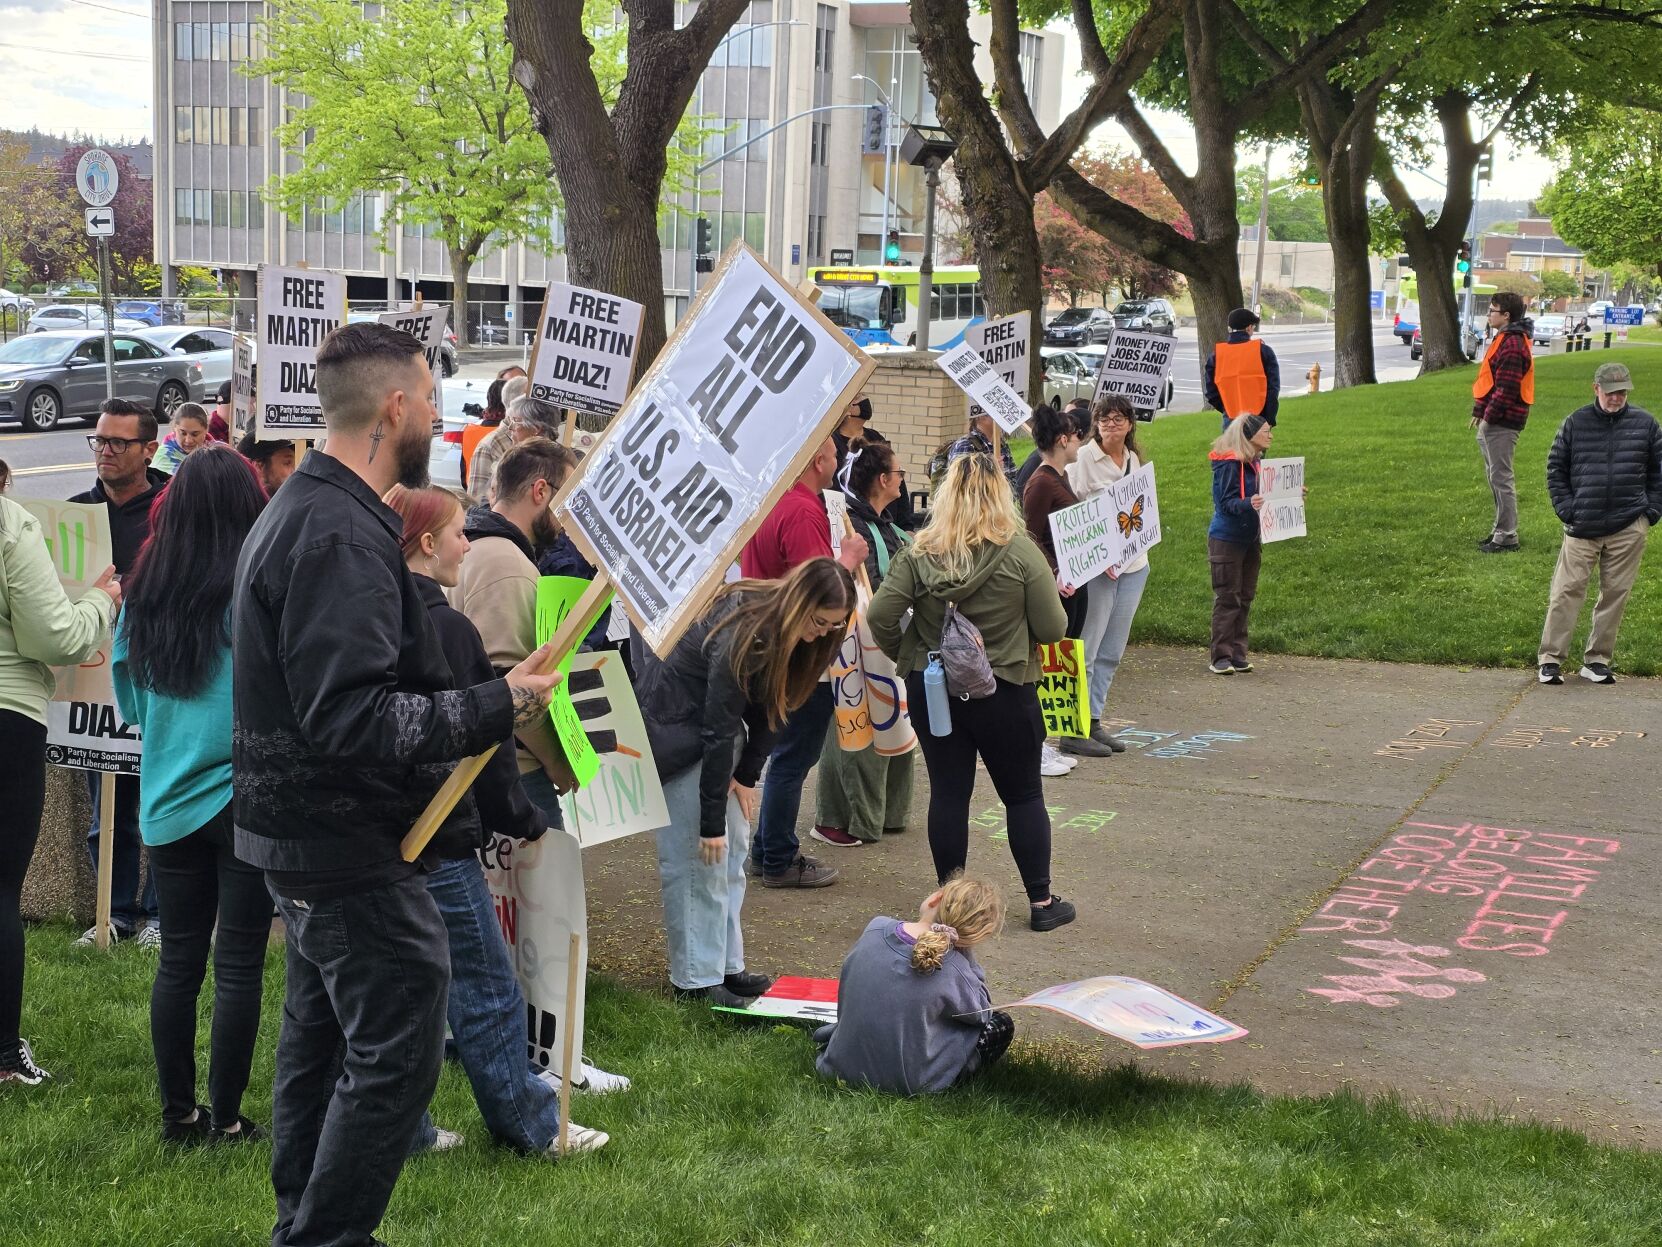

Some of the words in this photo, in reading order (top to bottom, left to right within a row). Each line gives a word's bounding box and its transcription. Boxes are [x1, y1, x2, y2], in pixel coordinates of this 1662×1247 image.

[282, 276, 325, 310] FREE
[568, 291, 621, 325] FREE
[545, 316, 634, 358] MARTIN
[723, 284, 817, 395] END
[983, 320, 1015, 346] FREE
[1114, 336, 1150, 350] MONEY
[1150, 341, 1171, 353] FOR
[552, 355, 611, 391] DIAZ!
[947, 353, 972, 374] DONATE
[967, 350, 977, 362] TO
[1107, 359, 1162, 378] EDUCATION,
[1110, 348, 1141, 361] JOBS
[1141, 350, 1168, 365] AND
[957, 365, 981, 389] MARTIN
[975, 361, 991, 378] DIAZ
[1101, 380, 1124, 393] NOT
[1125, 382, 1157, 397] MASS
[687, 353, 764, 456] ALL
[592, 450, 626, 502] TO
[621, 402, 681, 493] U.S.
[660, 460, 733, 545] AID
[582, 507, 597, 529] Party
[594, 523, 602, 537] for
[1055, 498, 1101, 534] PROTECT
[608, 478, 697, 592] ISRAEL!
[1058, 517, 1109, 557] IMMIGRANT
[1139, 525, 1158, 549] RIGHT
[1067, 543, 1109, 579] RIGHTS
[68, 701, 142, 741] DIAZ
[67, 747, 87, 758] Party
[88, 750, 100, 759] for
[100, 752, 139, 763] Socialism
[67, 757, 81, 766] and
[82, 758, 120, 771] Liberation
[1296, 821, 1473, 935] TOGETHER
[1423, 825, 1532, 896] BELONG
[1456, 832, 1621, 957] FAMILIES
